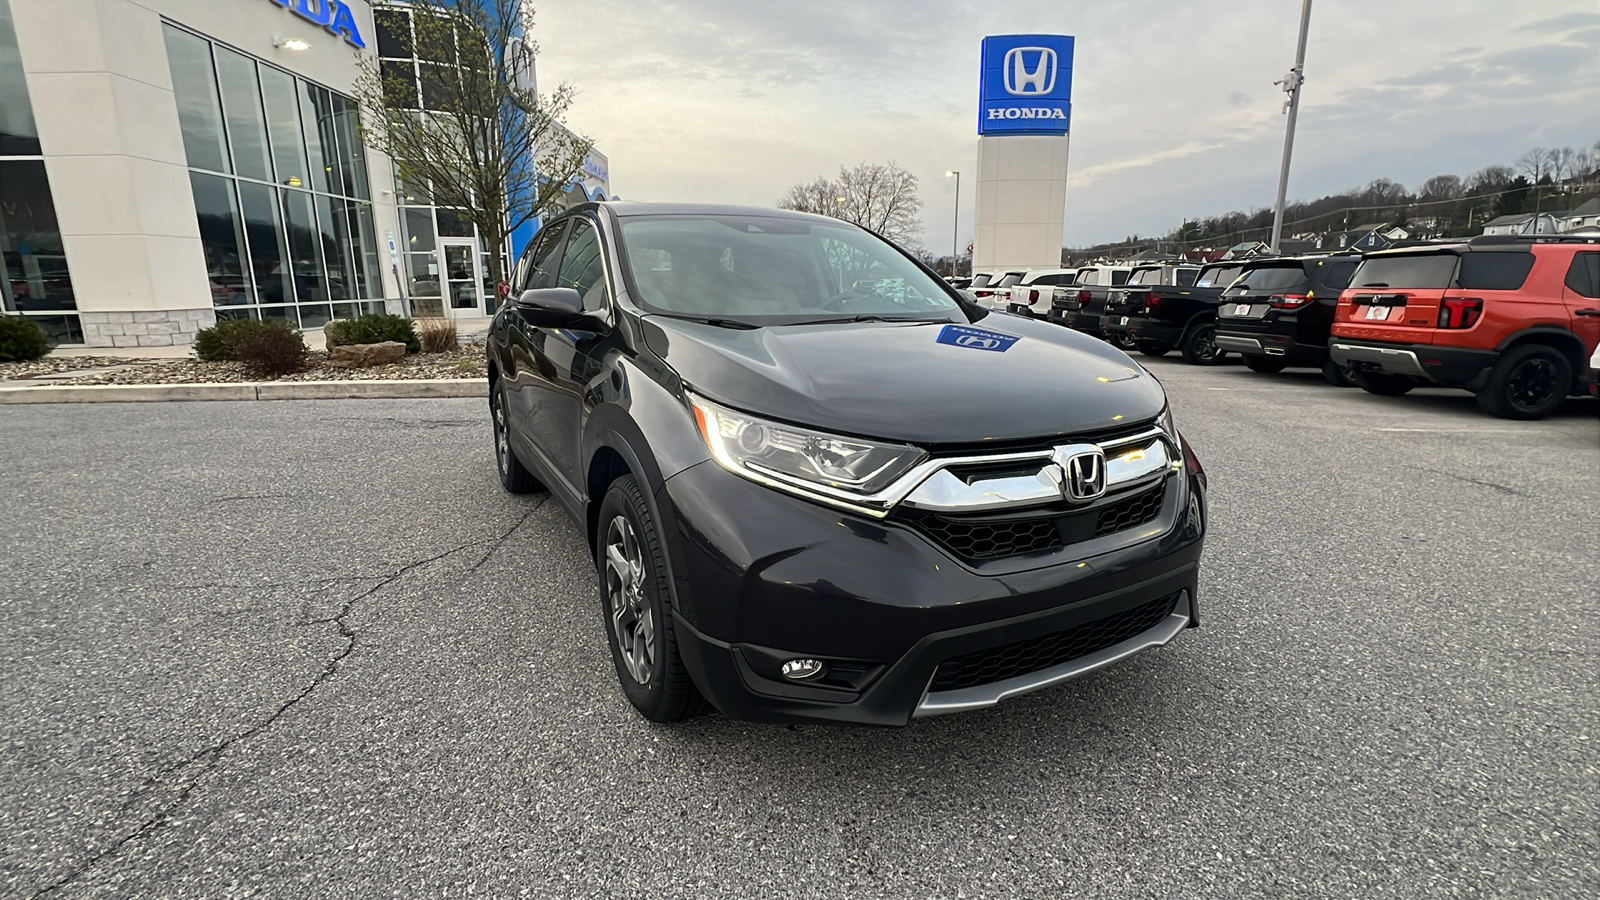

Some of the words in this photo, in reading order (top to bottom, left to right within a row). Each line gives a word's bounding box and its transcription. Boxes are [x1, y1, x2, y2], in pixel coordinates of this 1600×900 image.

[268, 0, 366, 49] DA
[987, 107, 1067, 120] HONDA
[1335, 327, 1421, 340] PASSPORT
